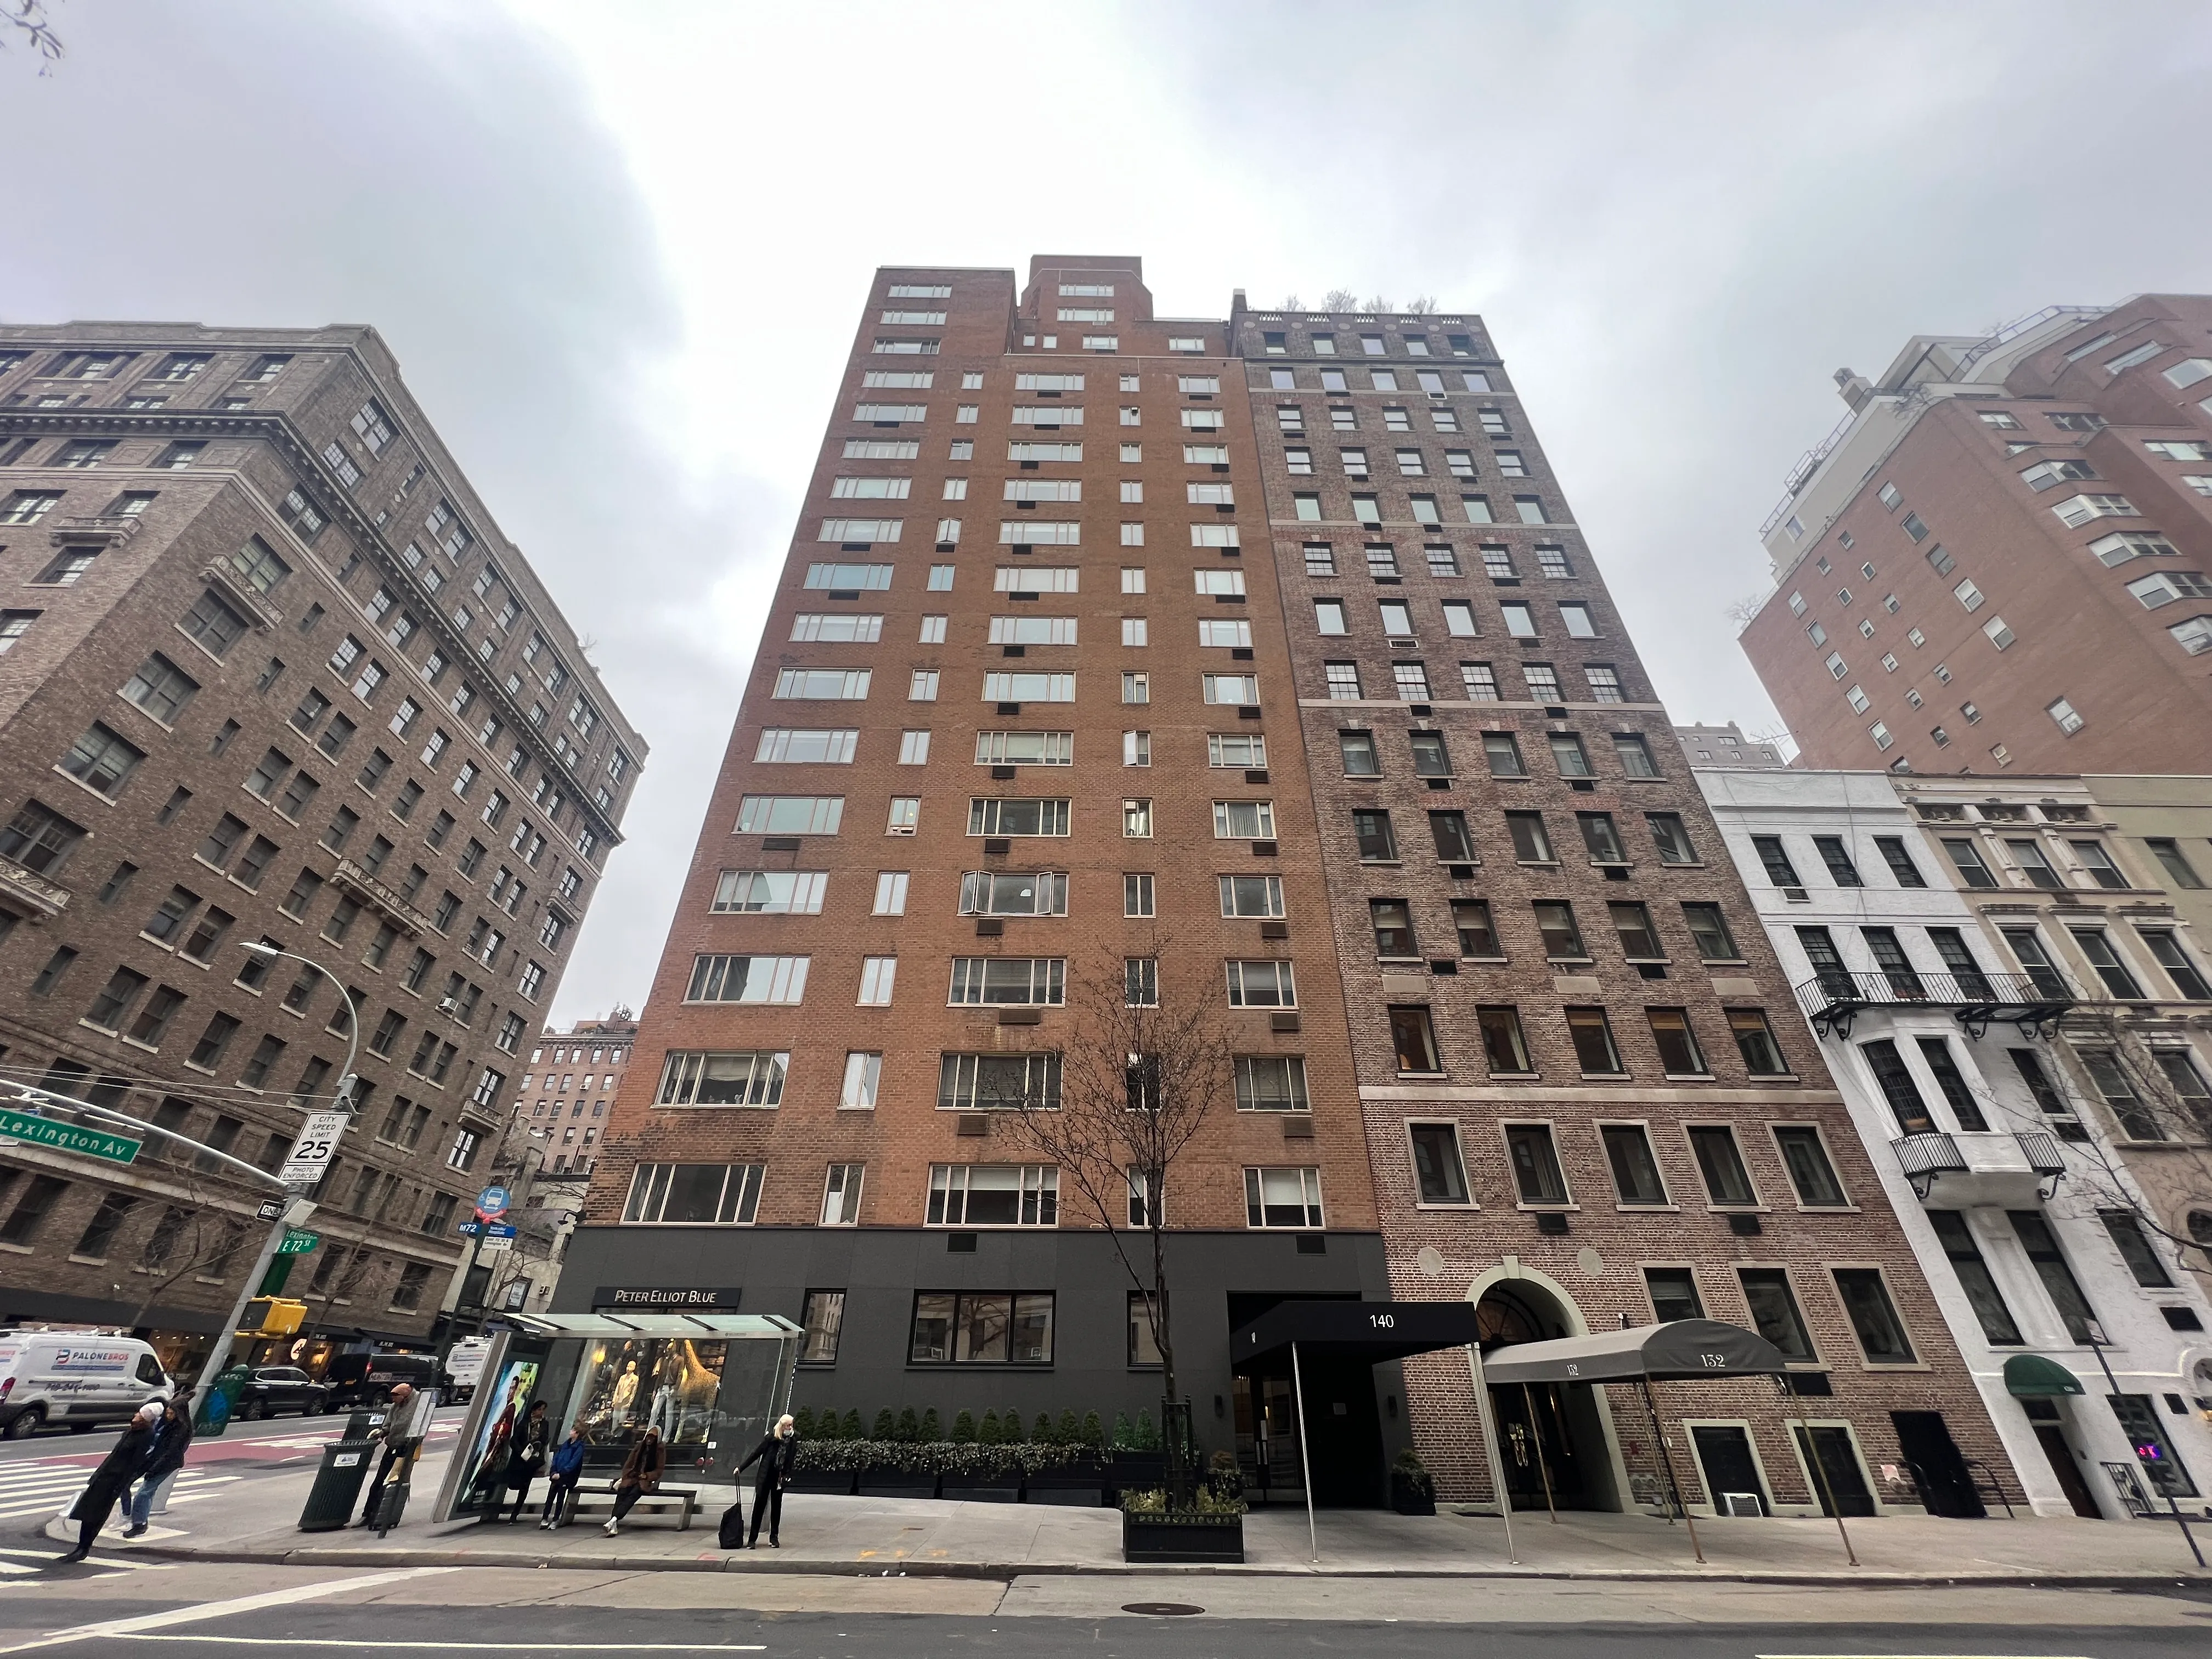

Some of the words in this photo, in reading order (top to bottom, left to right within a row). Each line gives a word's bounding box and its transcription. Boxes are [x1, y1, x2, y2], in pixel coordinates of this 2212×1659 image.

[0, 1115, 100, 1150] Lexington
[102, 1141, 126, 1155] Av
[294, 1141, 331, 1159] 25
[459, 1224, 477, 1232] M72
[282, 1240, 290, 1251] E
[291, 1240, 303, 1251] 72
[614, 1290, 649, 1302] PETER
[650, 1290, 686, 1302] ELLIOT
[688, 1290, 717, 1303] BLUE
[1370, 1314, 1394, 1328] 140
[1701, 1354, 1726, 1368] 132
[1566, 1364, 1579, 1376] 132
